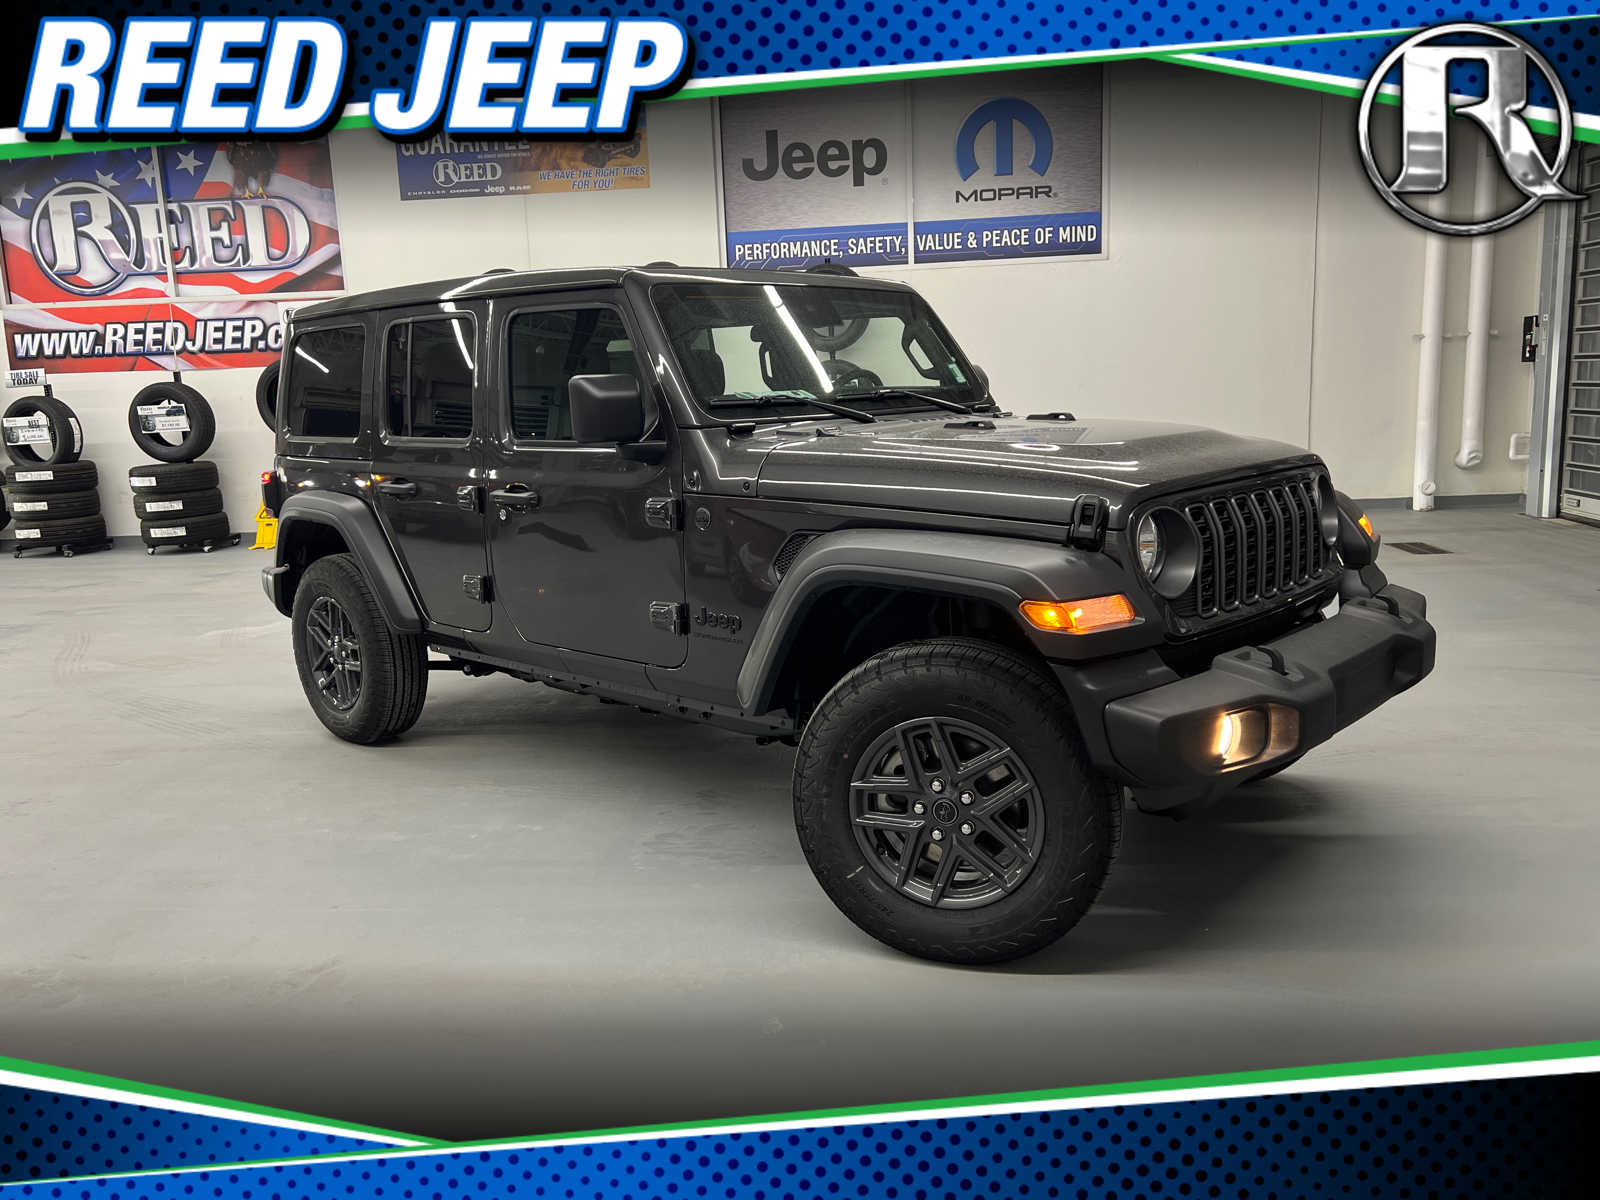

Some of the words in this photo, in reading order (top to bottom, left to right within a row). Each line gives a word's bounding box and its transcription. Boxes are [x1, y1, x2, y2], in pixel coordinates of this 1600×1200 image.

[742, 129, 888, 187] Jeep
[437, 160, 502, 184] REED
[540, 171, 552, 181] WE
[554, 170, 576, 180] HAVE
[578, 169, 593, 179] THE
[595, 167, 620, 178] RIGHT
[623, 166, 646, 177] TIRES
[484, 185, 505, 194] Jeep
[572, 180, 590, 190] FOR
[593, 178, 615, 189] YOU!
[955, 184, 1053, 204] MOPAR
[46, 190, 308, 276] REED
[735, 238, 844, 262] PERFORMANCE,
[848, 234, 906, 257] SAFETY,
[916, 231, 963, 251] VALUE
[967, 231, 978, 249] &
[982, 229, 1030, 248] PEACE
[1034, 227, 1054, 244] OF
[1059, 224, 1098, 244] MIND
[12, 378, 39, 386] TODAY
[694, 606, 742, 635] Jeep
